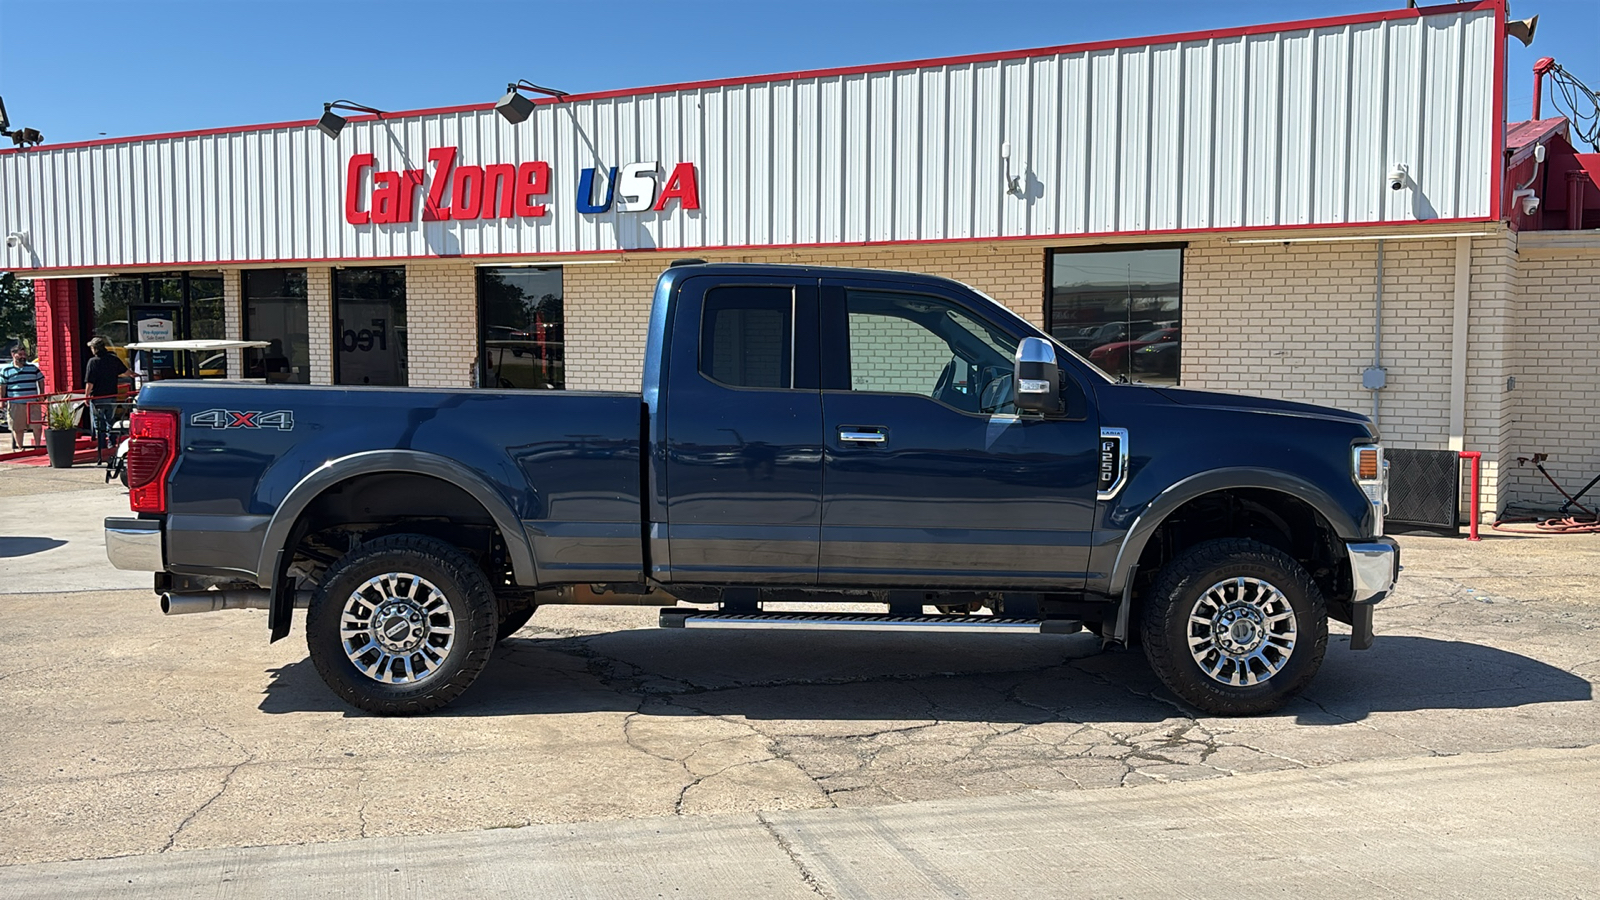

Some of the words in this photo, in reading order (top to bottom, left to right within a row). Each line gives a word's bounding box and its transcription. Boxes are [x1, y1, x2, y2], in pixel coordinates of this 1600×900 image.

[345, 146, 549, 225] CarZone
[577, 161, 700, 213] USA
[1101, 441, 1115, 481] F250
